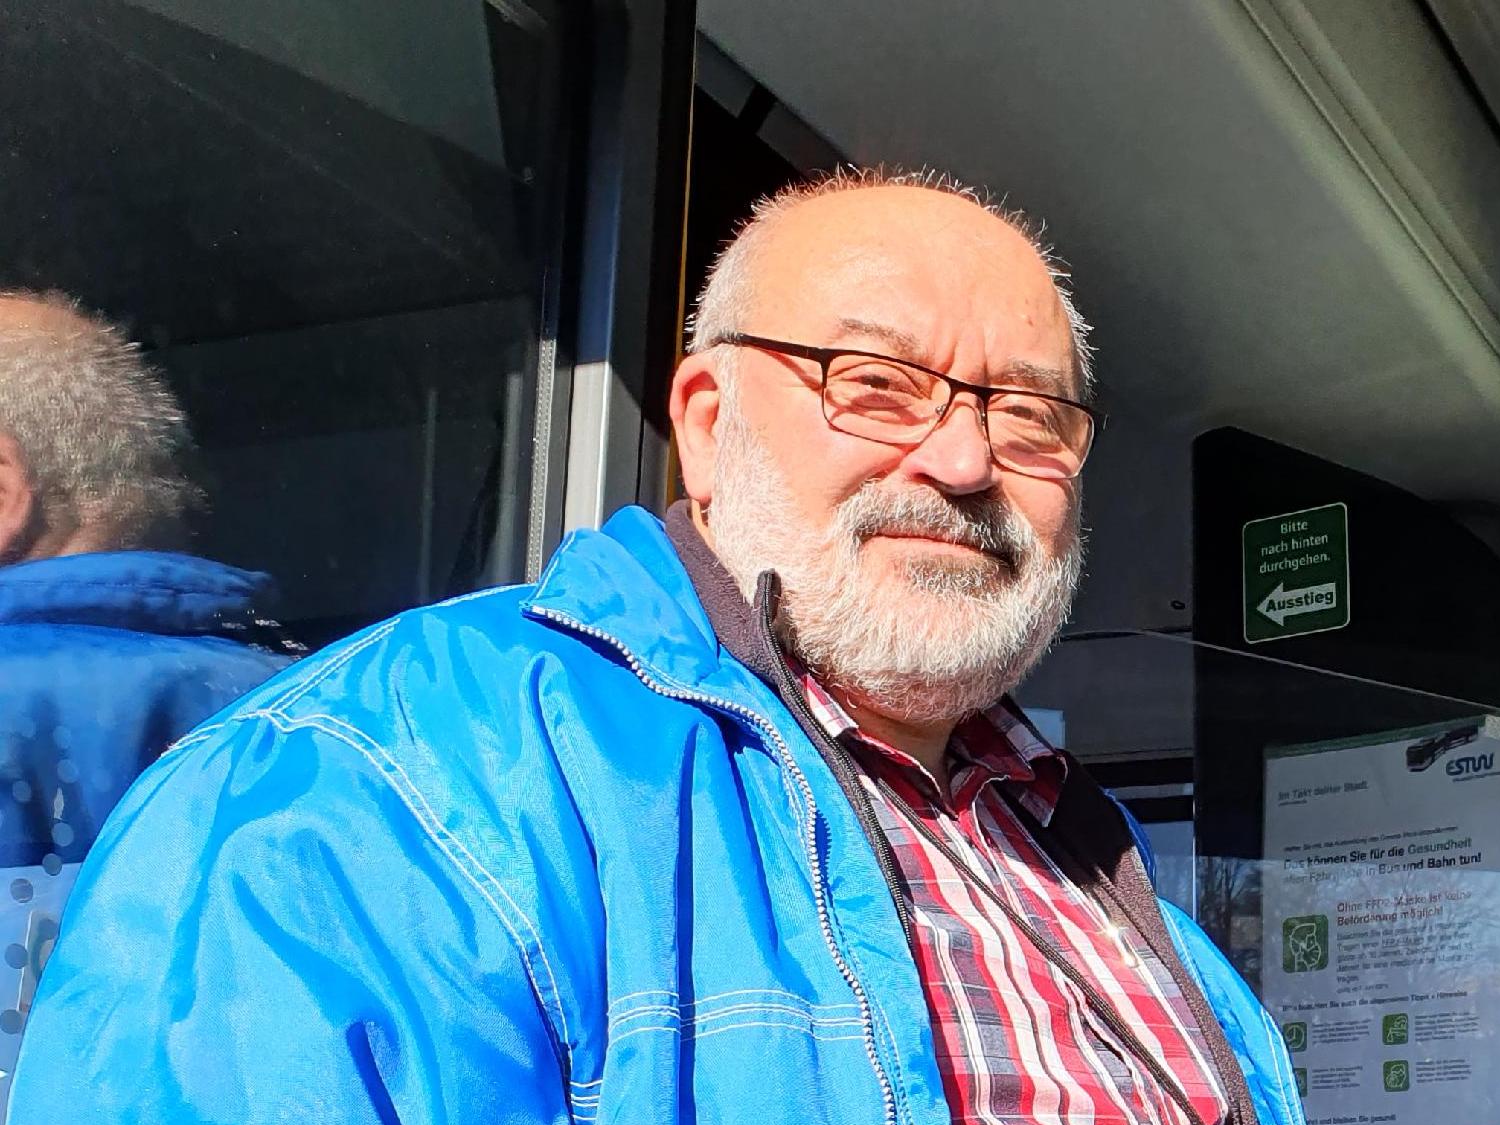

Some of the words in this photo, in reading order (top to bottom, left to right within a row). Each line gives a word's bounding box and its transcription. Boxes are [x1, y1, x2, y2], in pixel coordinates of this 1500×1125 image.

[1280, 521, 1308, 534] Bitte
[1261, 541, 1288, 556] nach
[1291, 534, 1328, 550] hinten
[1259, 553, 1330, 574] durchgehen.
[1266, 591, 1333, 612] Ausstieg
[1307, 855, 1346, 868] können
[1350, 851, 1367, 862] Sie
[1370, 848, 1384, 860] für
[1388, 846, 1405, 857] die
[1407, 837, 1472, 855] Gesundheit
[1403, 859, 1424, 871] und
[1427, 855, 1456, 869] Bahn
[1459, 852, 1481, 865] tun!
